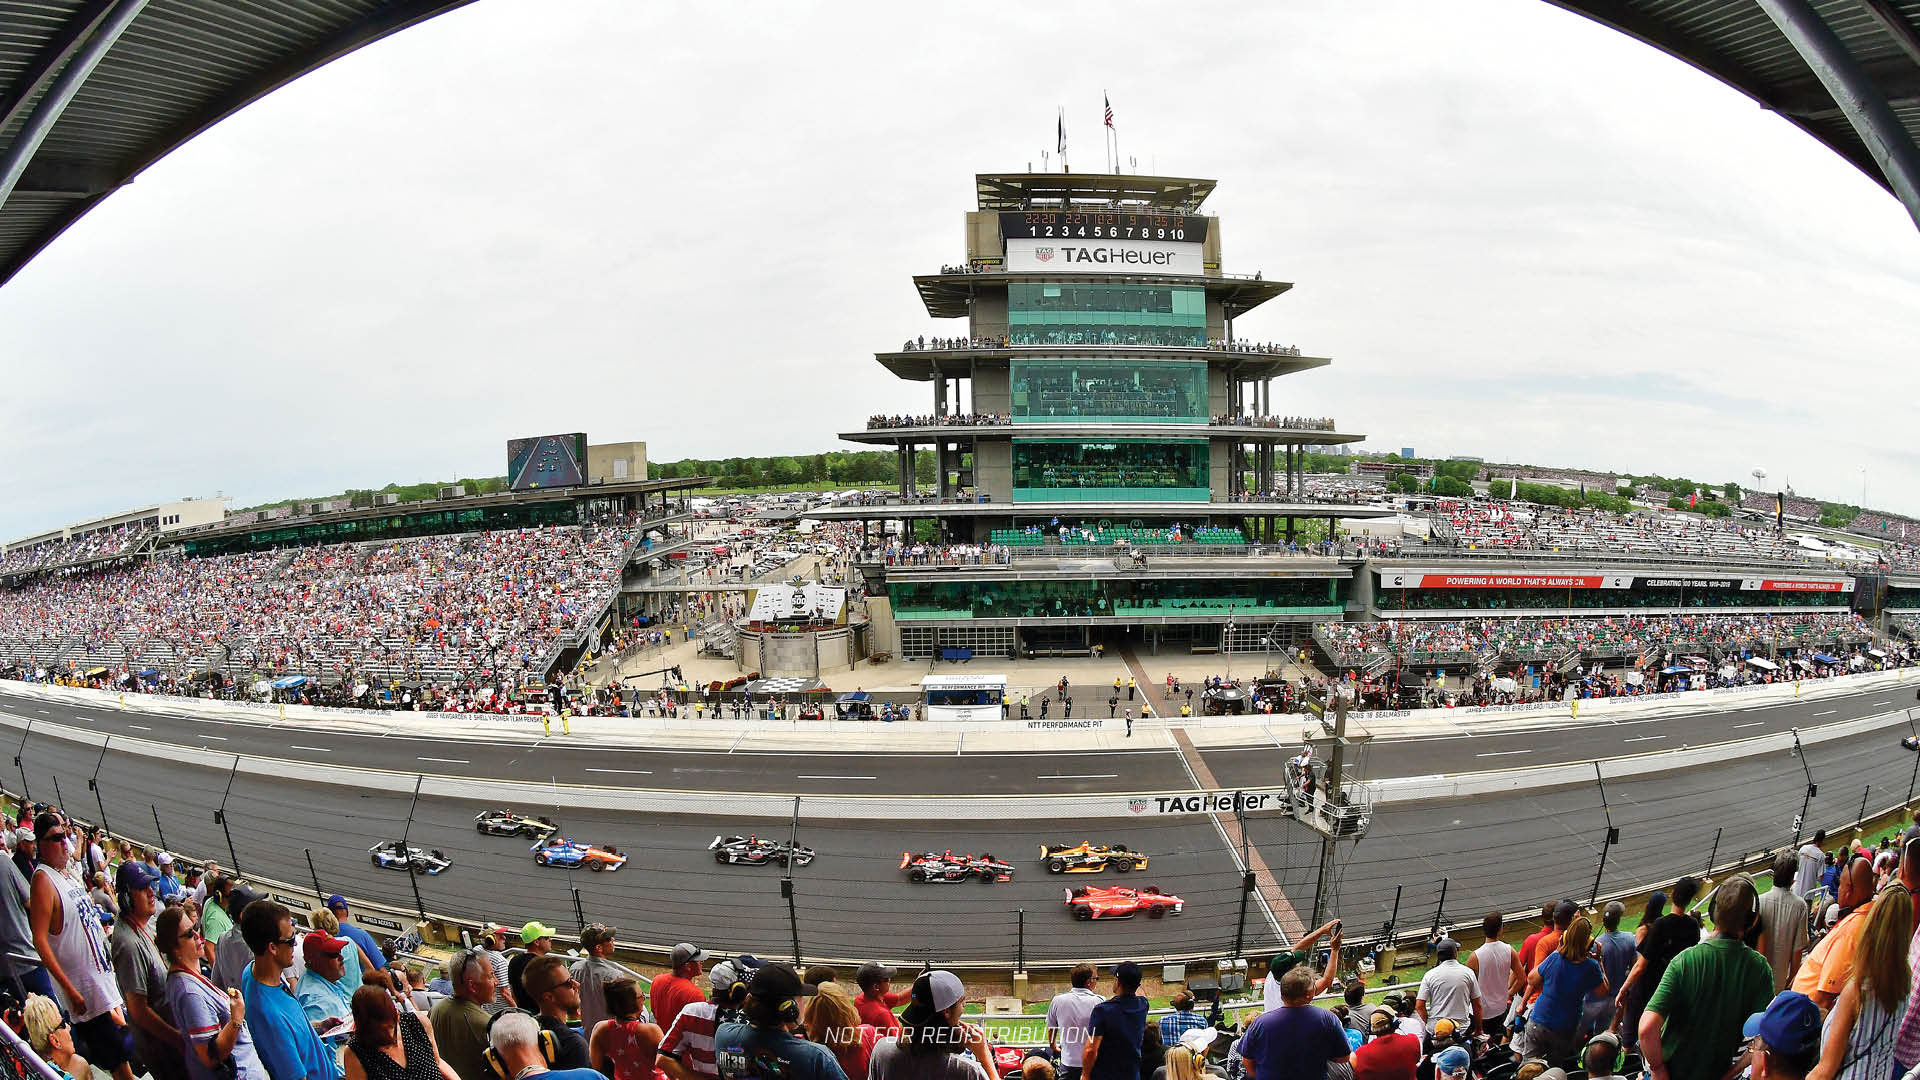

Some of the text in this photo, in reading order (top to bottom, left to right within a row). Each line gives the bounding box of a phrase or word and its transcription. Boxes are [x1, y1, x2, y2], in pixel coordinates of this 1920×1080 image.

[1029, 225, 1185, 240] 1 2 3 4 5 6 7 8 9 10
[1446, 577, 1487, 585] POWERING
[1488, 577, 1495, 585] A
[1496, 577, 1522, 585] WORLD
[1547, 578, 1573, 586] ALWAYS
[1646, 579, 1682, 587] CELEBRATING
[791, 597, 807, 605] 500
[1375, 710, 1411, 719] SEALMASTER
[1027, 720, 1103, 729] NTT PERFORMANCE PIT
